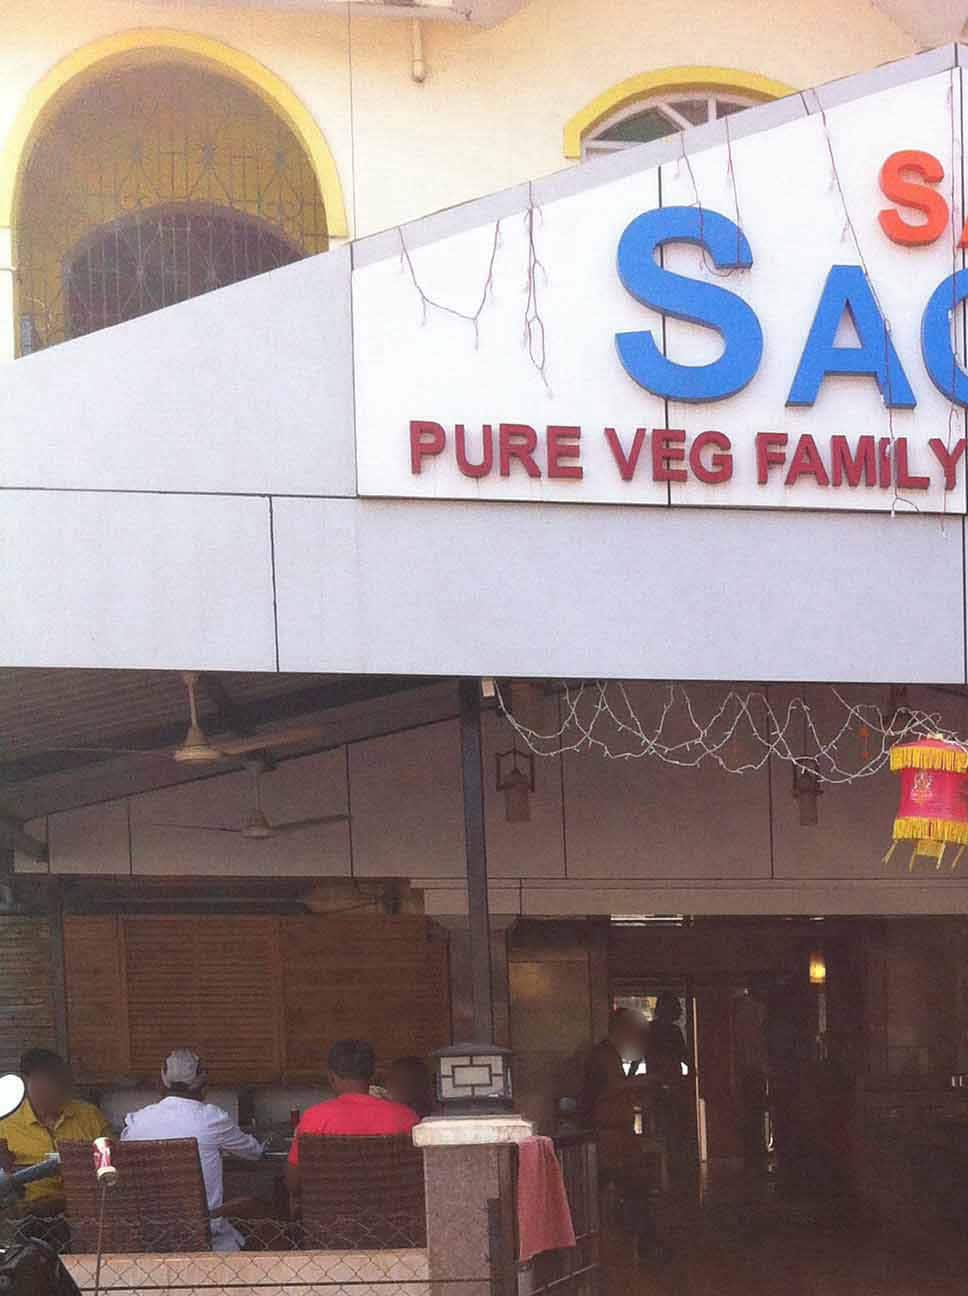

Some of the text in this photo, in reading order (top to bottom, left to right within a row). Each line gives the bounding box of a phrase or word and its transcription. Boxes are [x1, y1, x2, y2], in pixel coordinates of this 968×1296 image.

[409, 420, 583, 480] PURE
[604, 427, 733, 484] VEG
[756, 431, 968, 490] FAMILY
